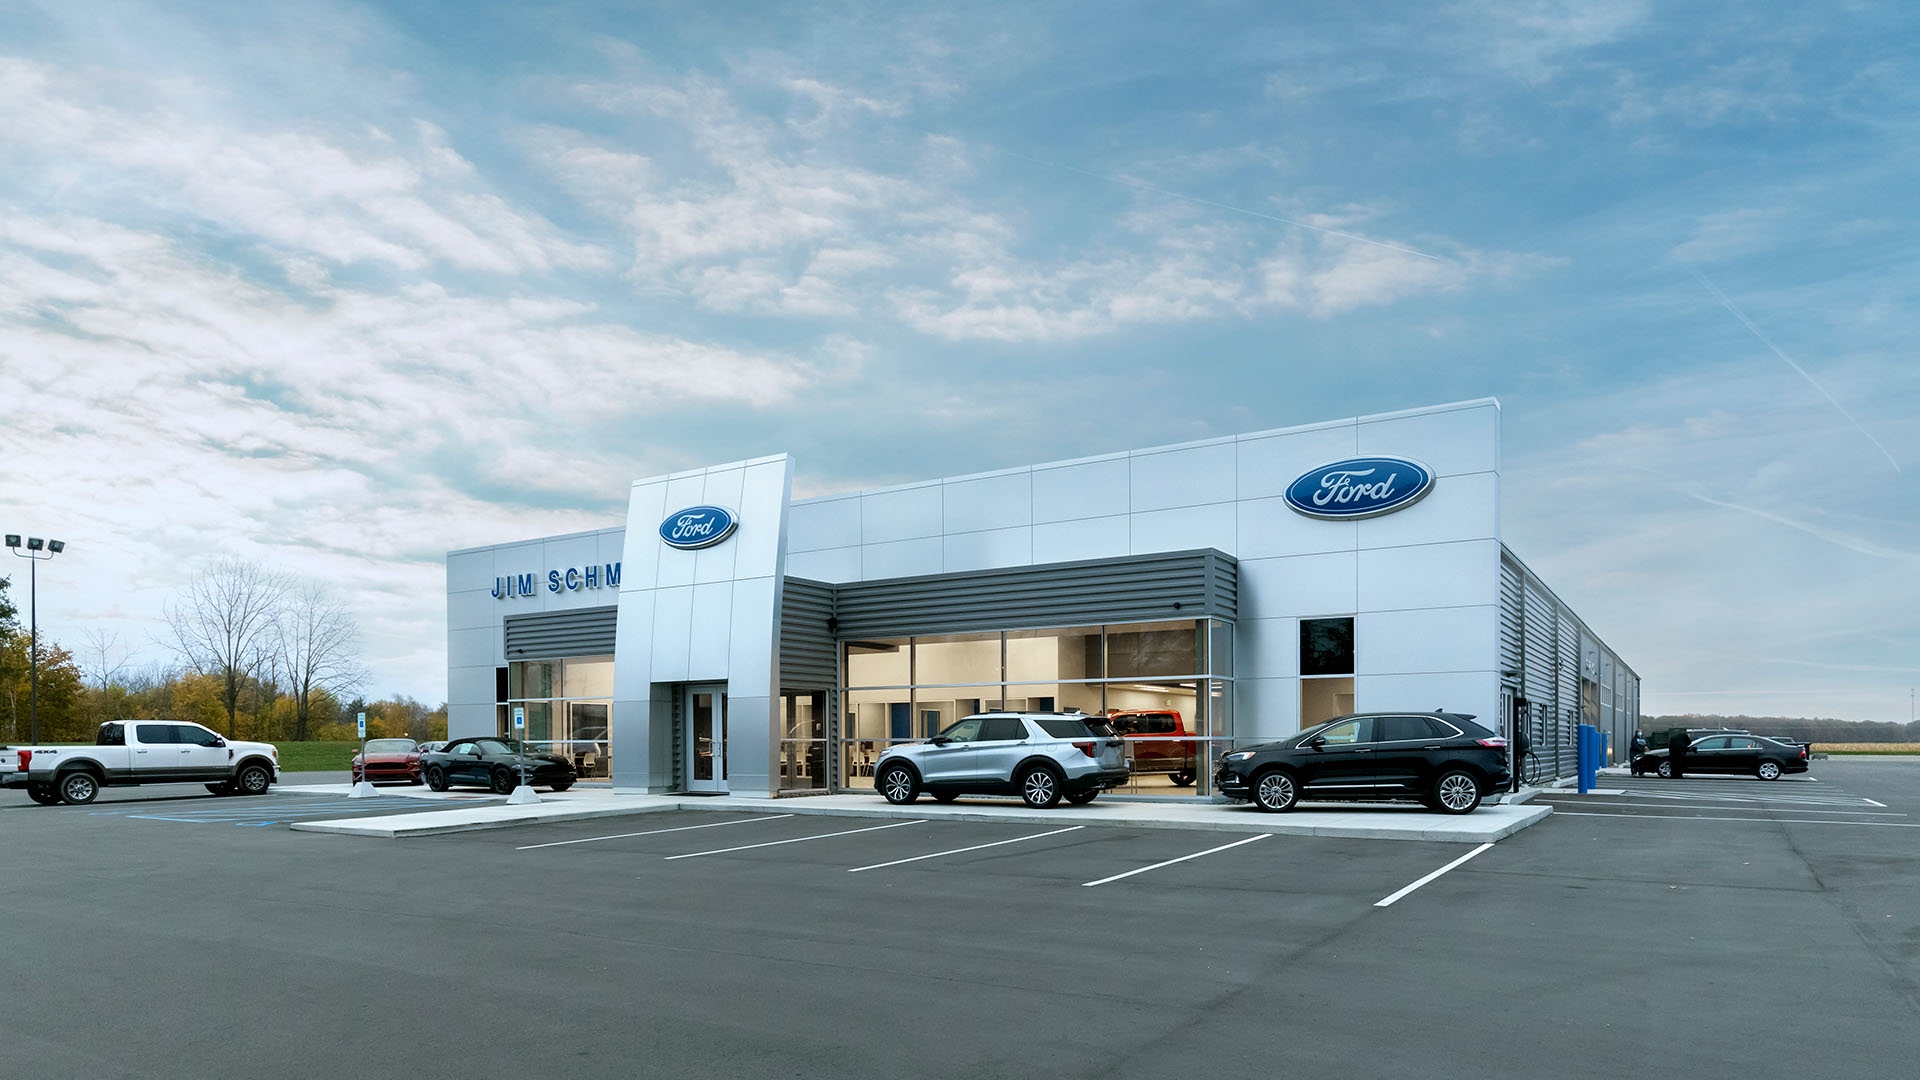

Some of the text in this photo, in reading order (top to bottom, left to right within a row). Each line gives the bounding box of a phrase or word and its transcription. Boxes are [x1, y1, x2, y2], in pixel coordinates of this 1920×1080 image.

[1312, 468, 1397, 506] Ford
[671, 513, 716, 539] Ford
[491, 573, 532, 598] JIM
